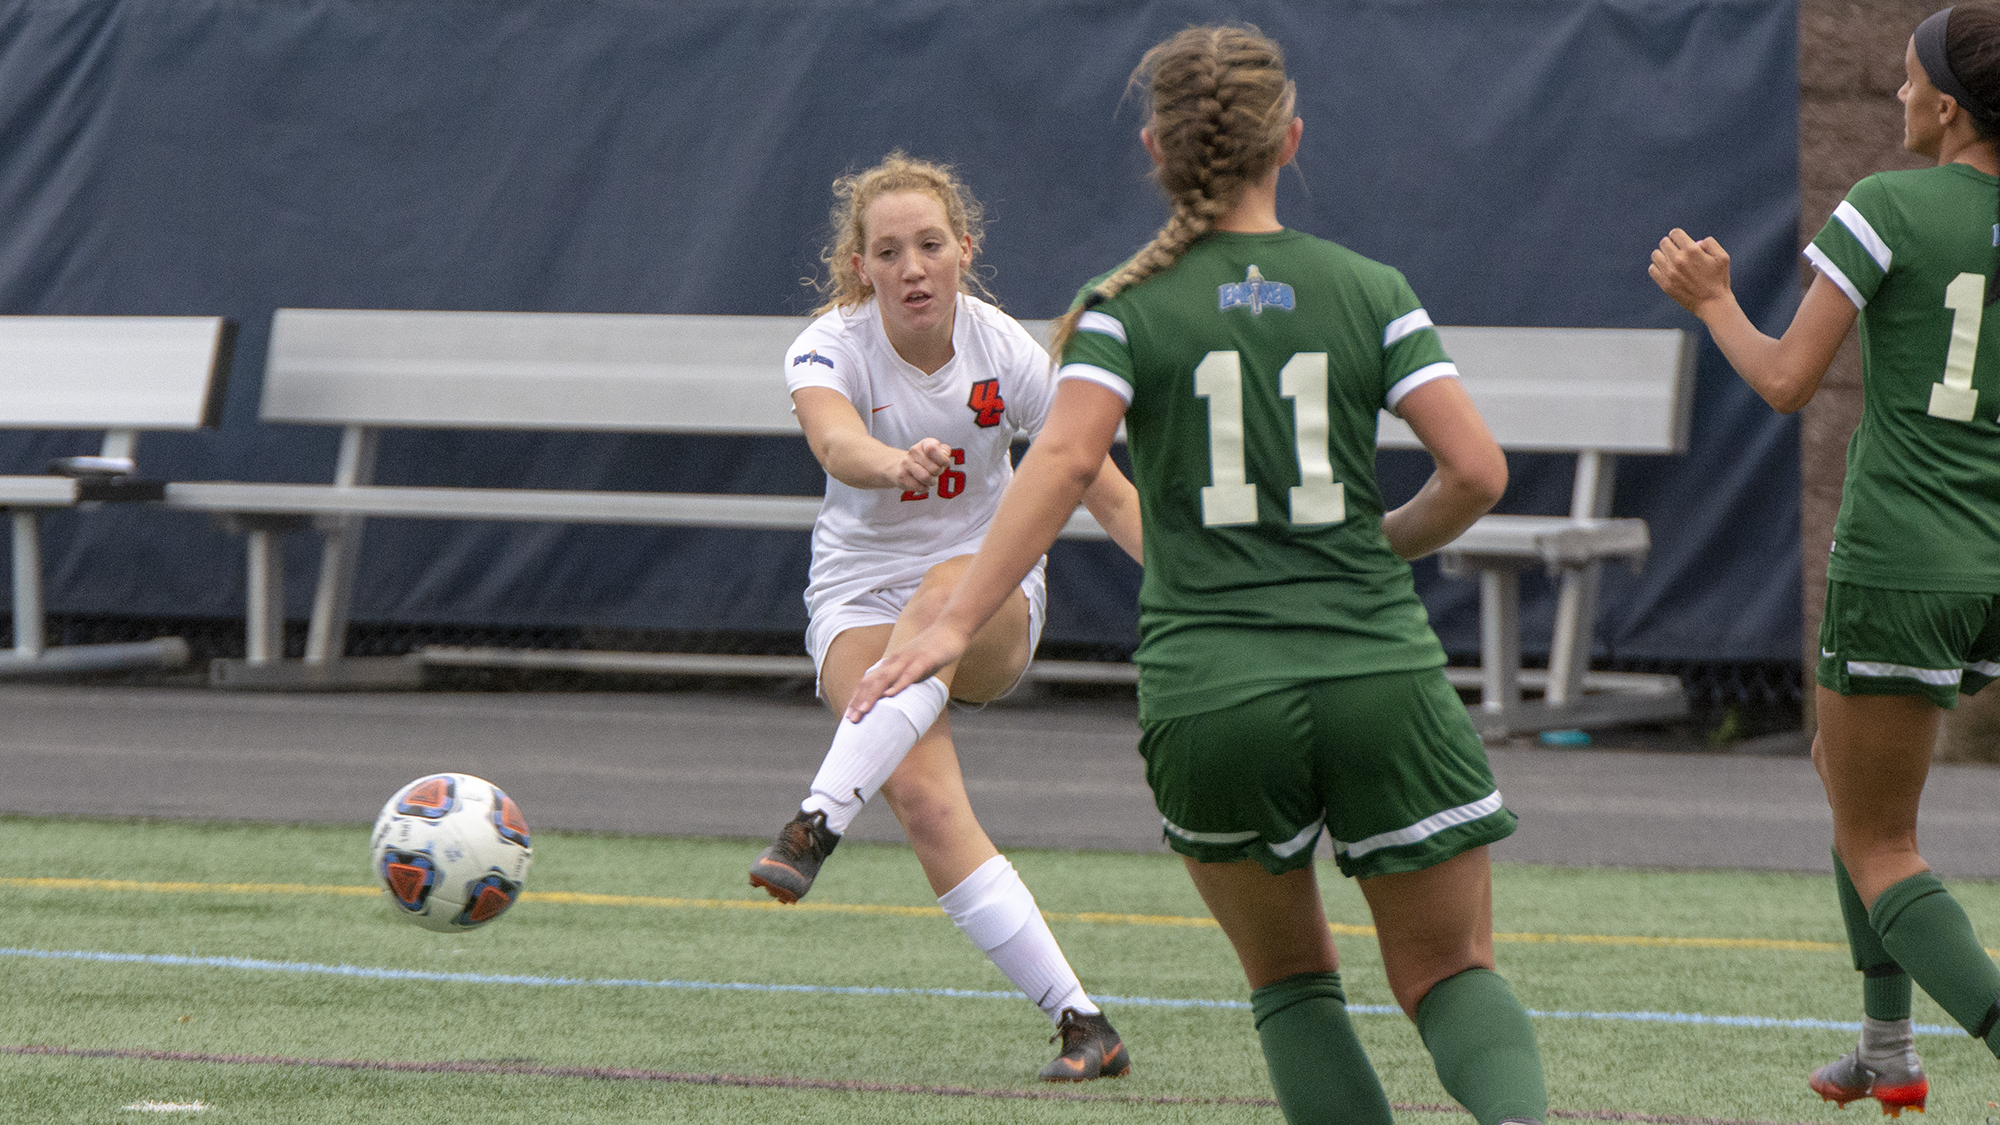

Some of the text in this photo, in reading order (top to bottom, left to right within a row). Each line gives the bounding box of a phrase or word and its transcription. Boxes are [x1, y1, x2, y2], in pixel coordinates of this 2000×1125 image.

[1927, 272, 2000, 423] 1
[901, 447, 966, 502] 6
[1194, 350, 1345, 526] 11
